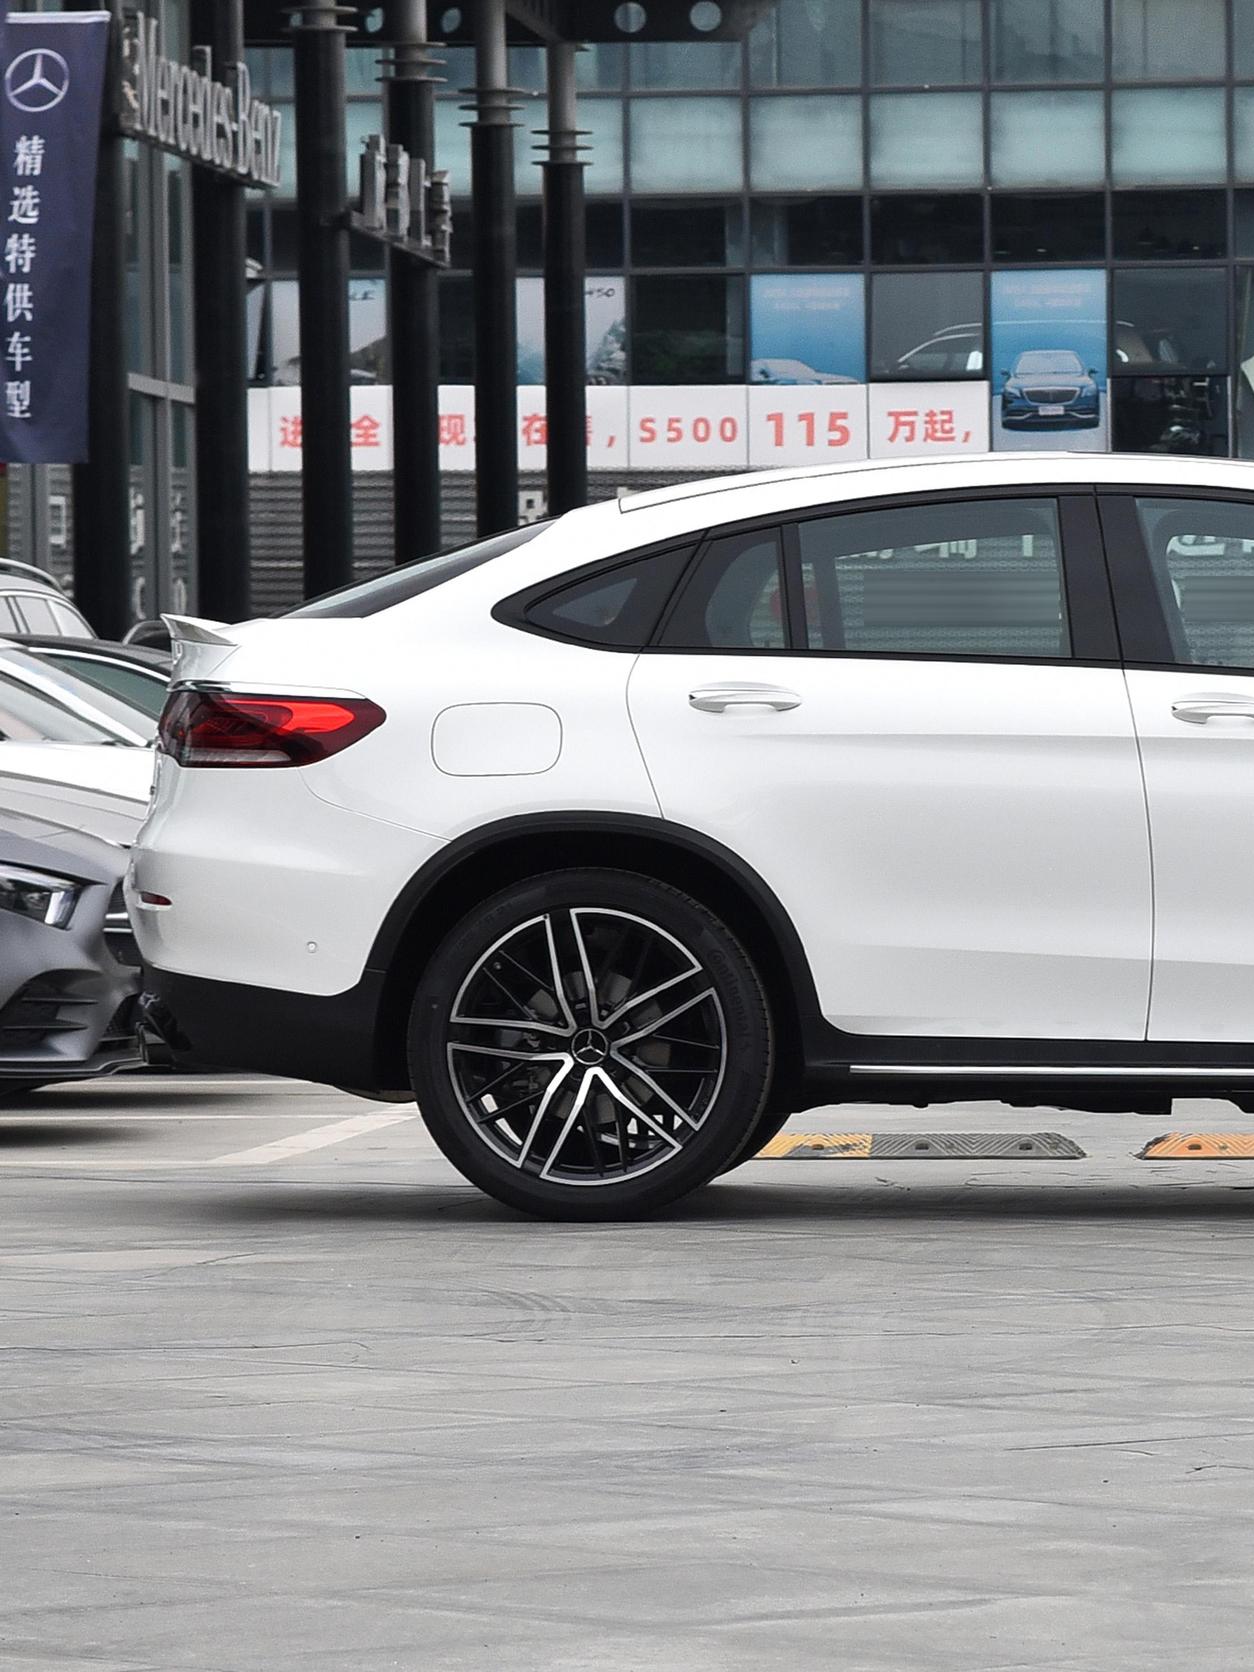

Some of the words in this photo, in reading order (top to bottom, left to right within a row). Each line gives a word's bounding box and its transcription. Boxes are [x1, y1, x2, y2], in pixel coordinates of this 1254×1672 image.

[5, 135, 45, 418] 精选特供车型
[639, 416, 738, 443] S500
[766, 411, 851, 447] 115
